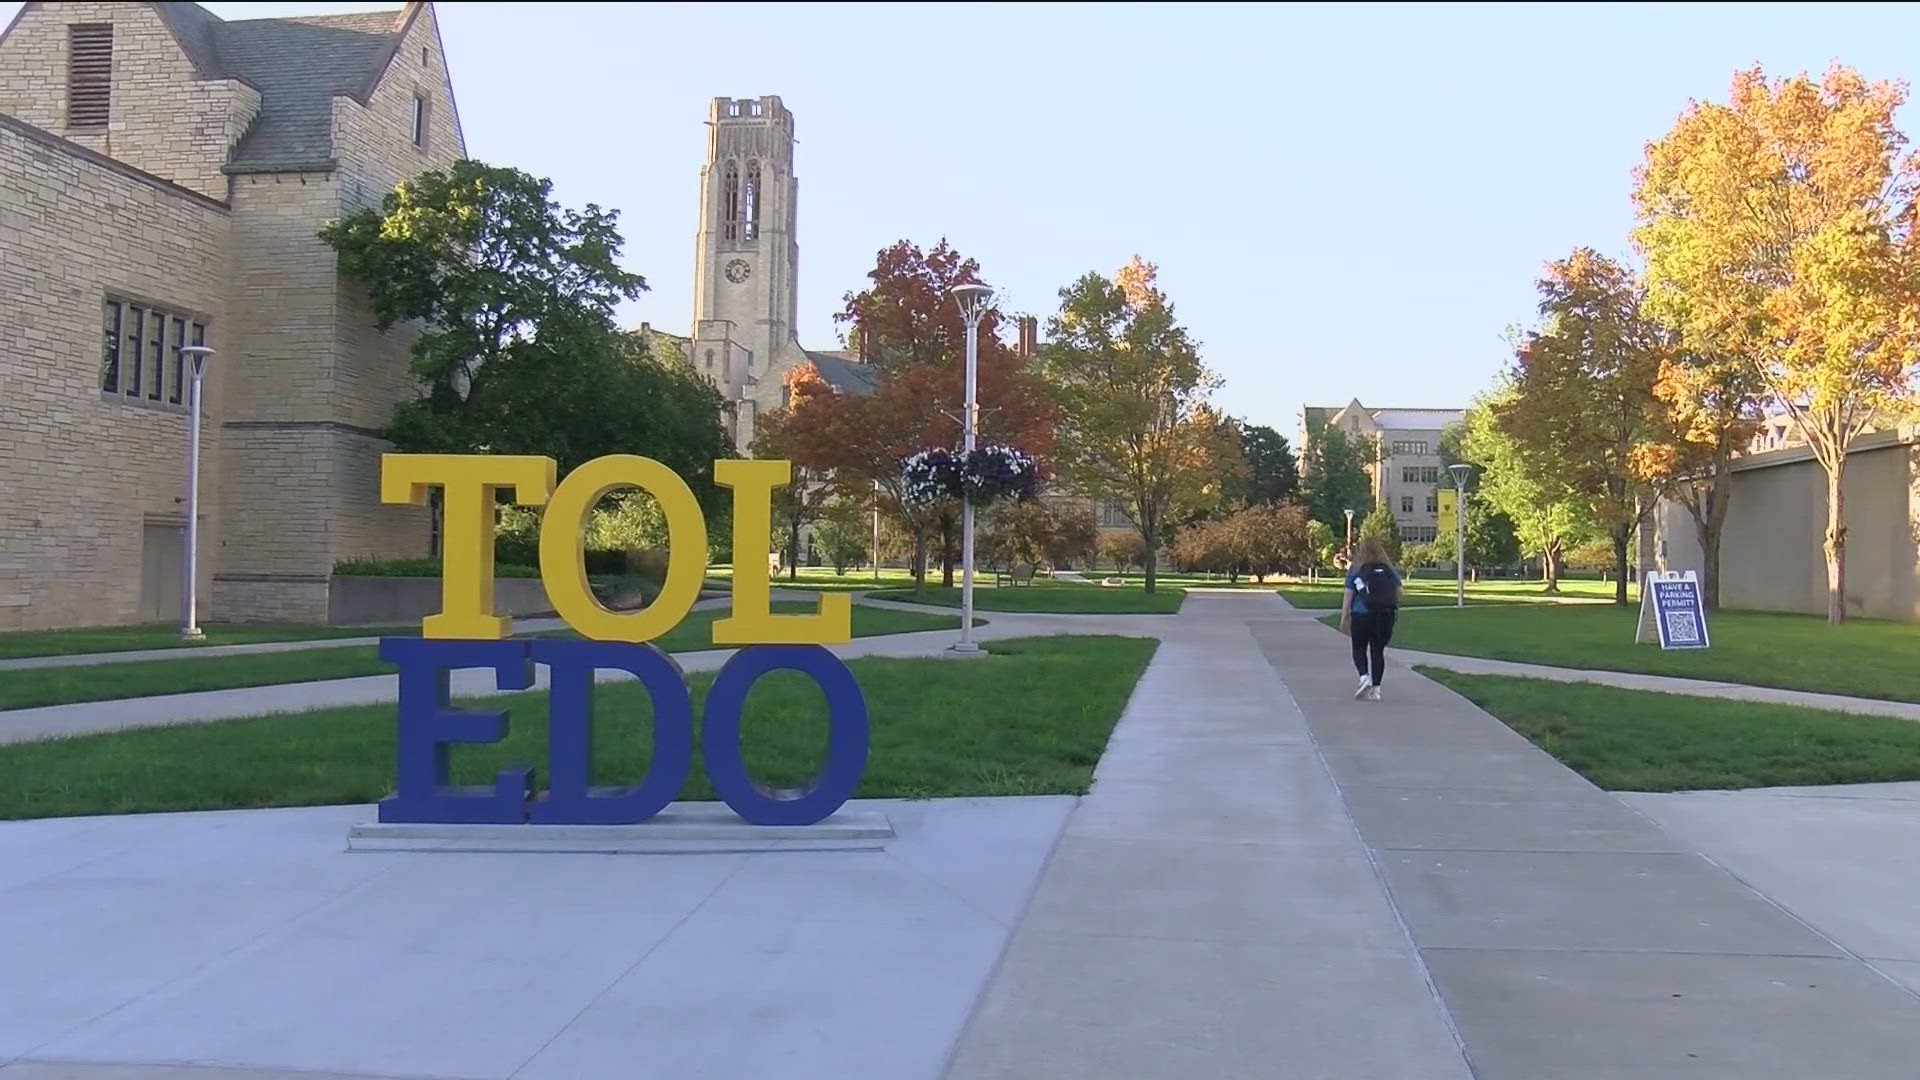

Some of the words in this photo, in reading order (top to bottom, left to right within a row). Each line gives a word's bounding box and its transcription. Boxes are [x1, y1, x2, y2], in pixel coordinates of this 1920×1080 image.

[381, 453, 852, 644] TOL
[1661, 583, 1682, 591] HAVE
[1684, 583, 1691, 591] A
[378, 636, 870, 826] EDO
